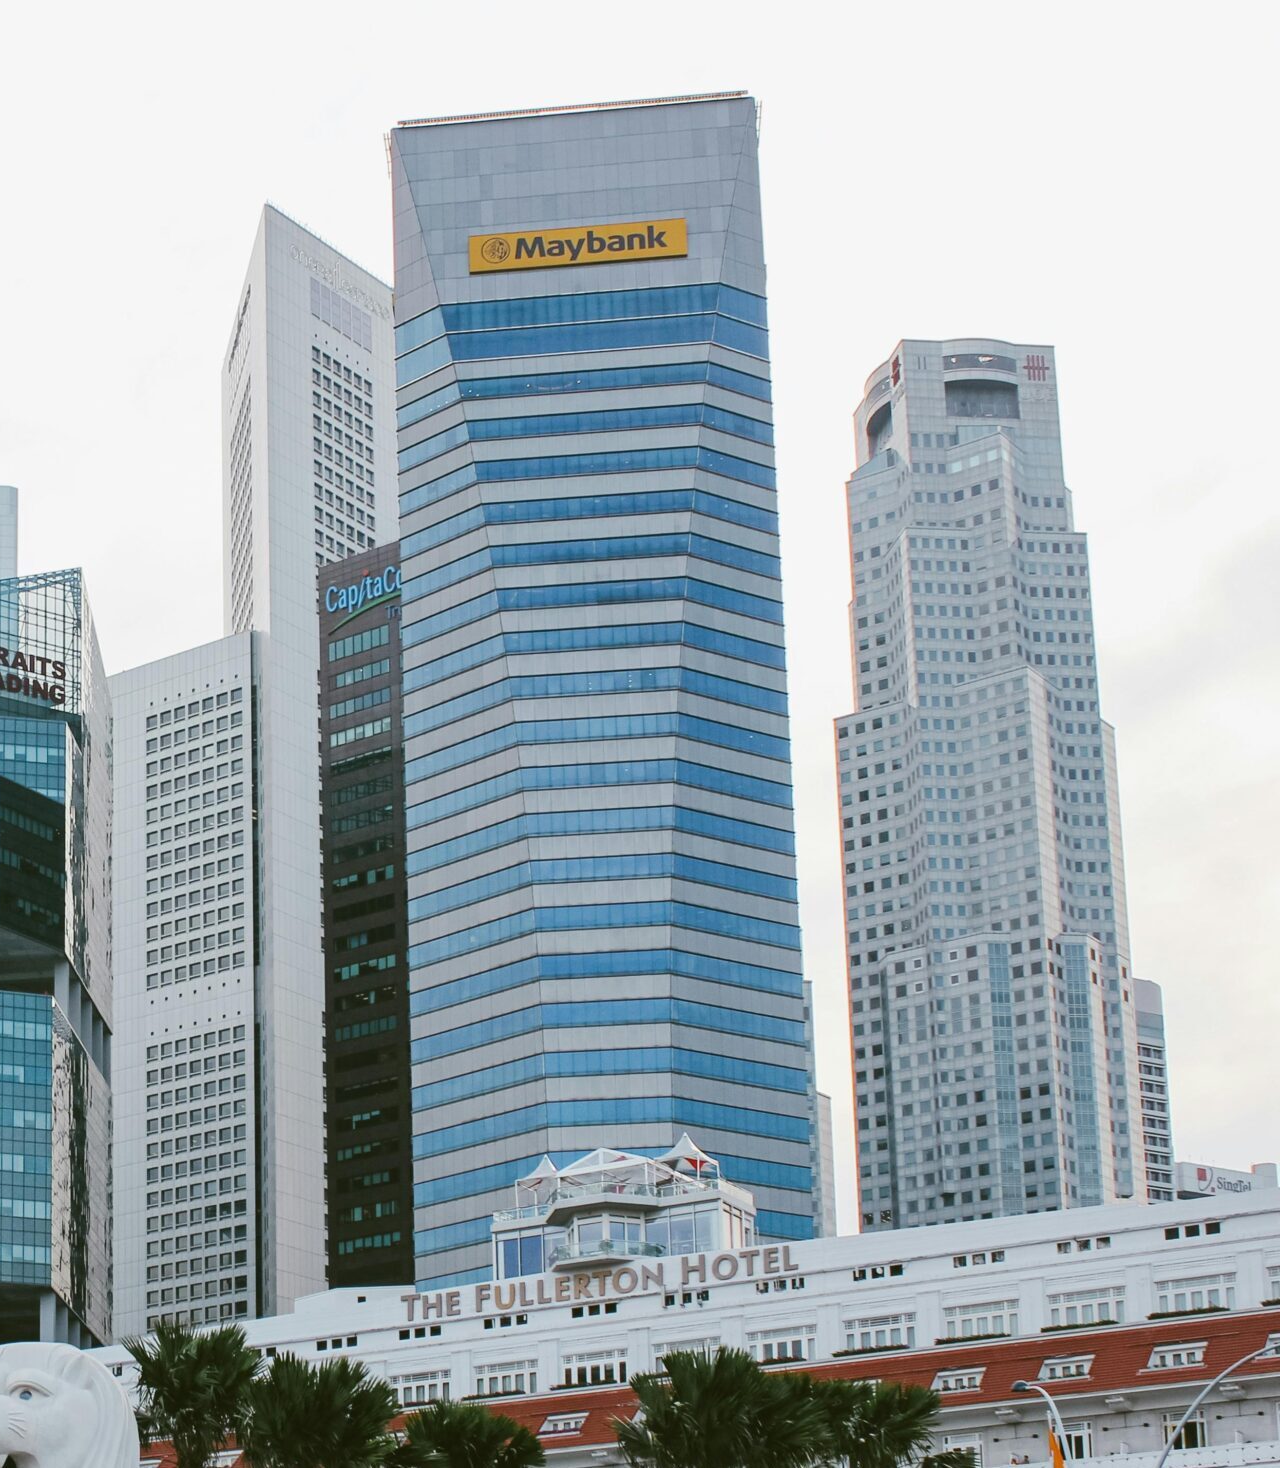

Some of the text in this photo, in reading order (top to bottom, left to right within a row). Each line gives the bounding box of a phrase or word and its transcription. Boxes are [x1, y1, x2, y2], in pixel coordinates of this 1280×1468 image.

[514, 225, 668, 261] Maybank
[1216, 1176, 1252, 1193] SingTel
[401, 1245, 800, 1322] THE FULLERTON HOTEL
